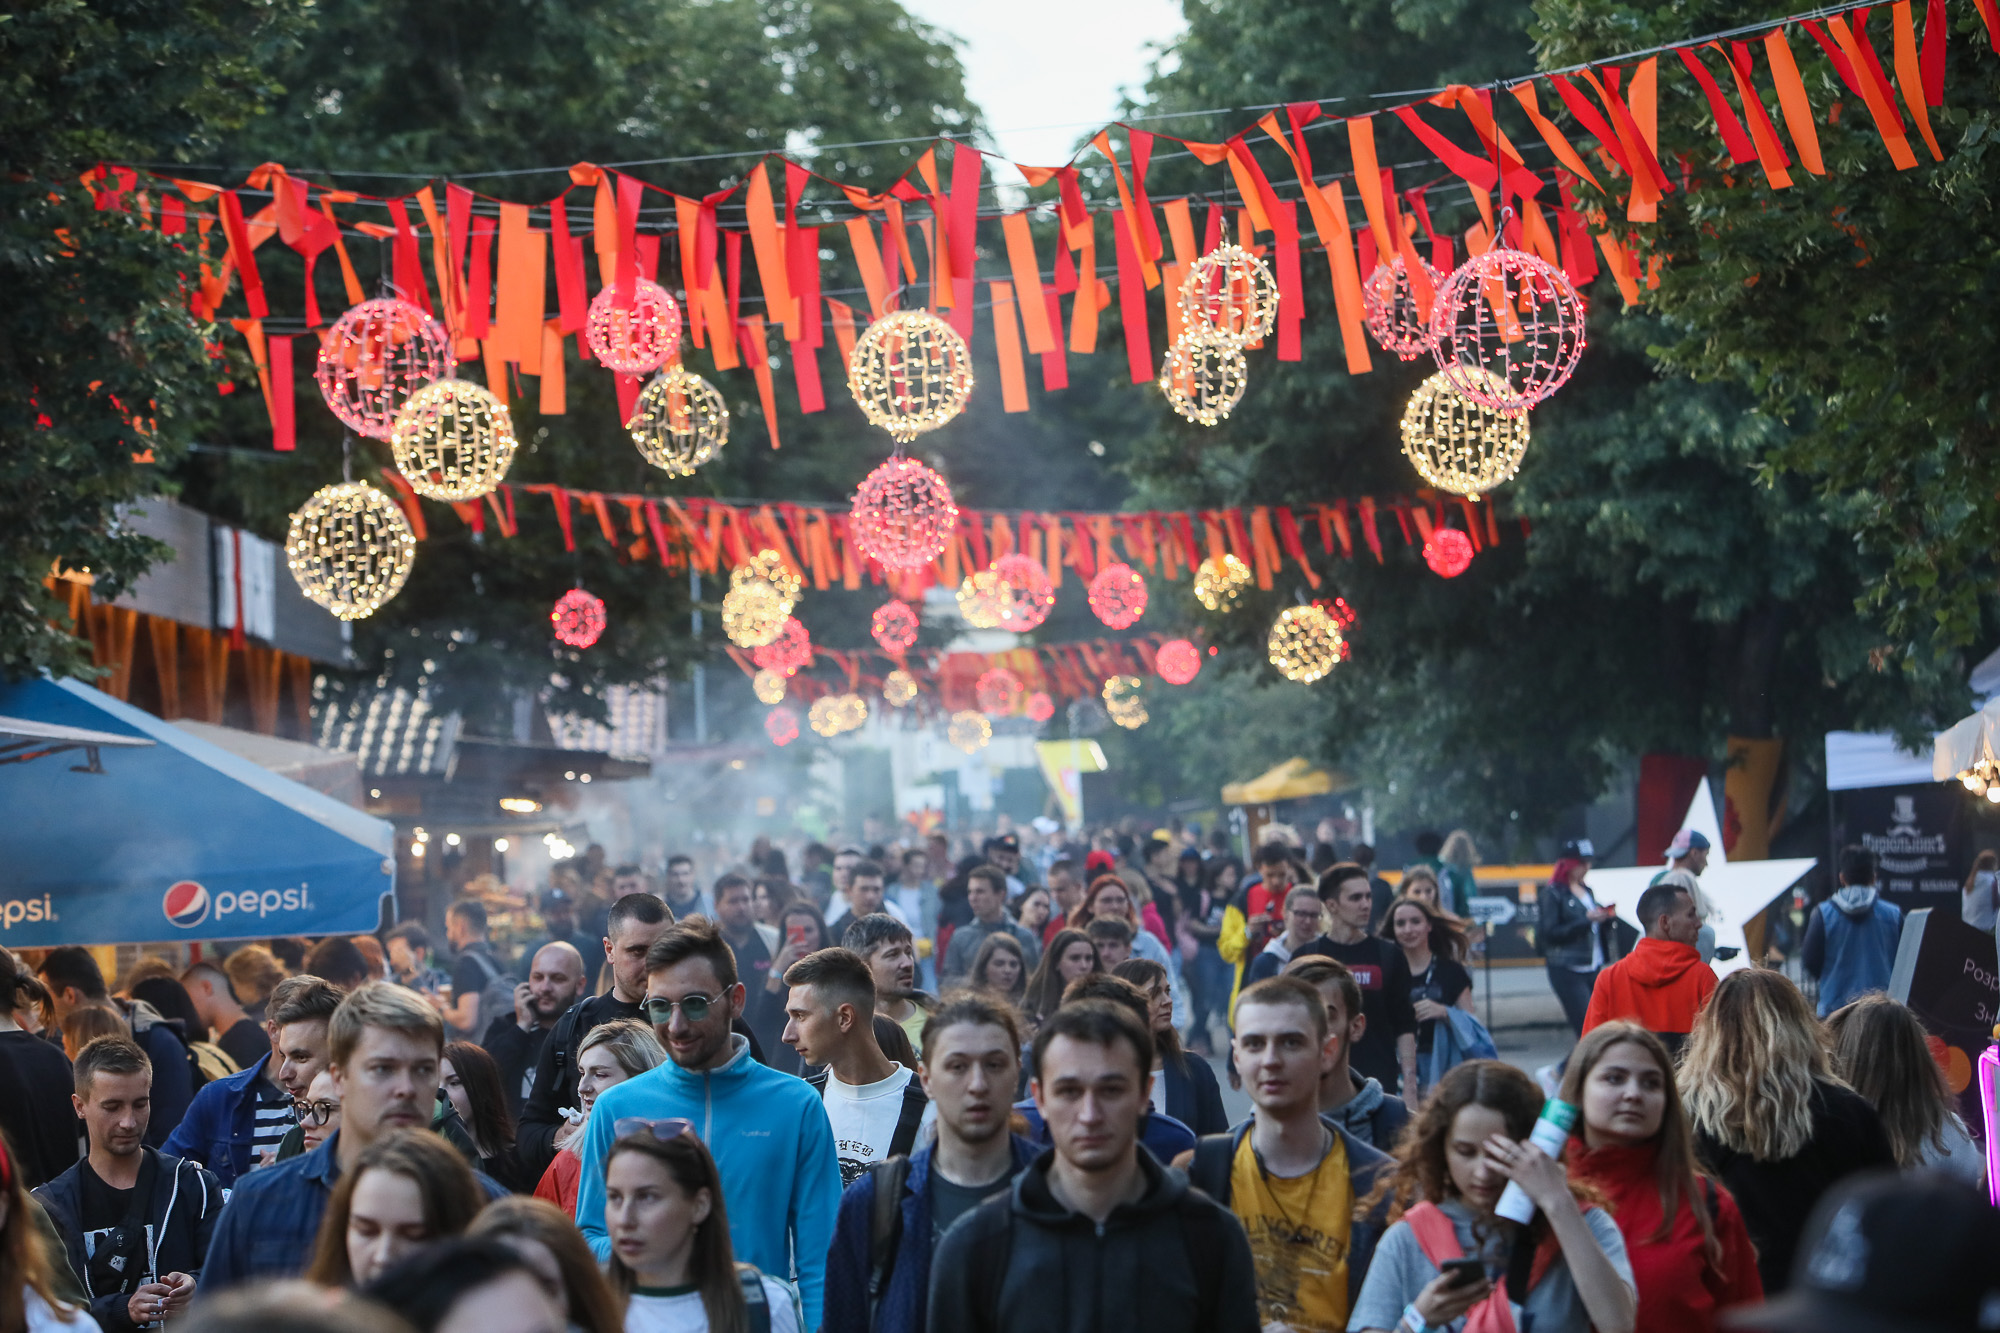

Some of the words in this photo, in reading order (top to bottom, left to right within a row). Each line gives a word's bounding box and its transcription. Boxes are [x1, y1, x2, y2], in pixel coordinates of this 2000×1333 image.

[0, 892, 51, 930] psi
[215, 883, 308, 921] pepsi
[1353, 971, 1371, 985] ON
[1963, 957, 2000, 991] Розр
[1974, 1001, 1999, 1026] Зн
